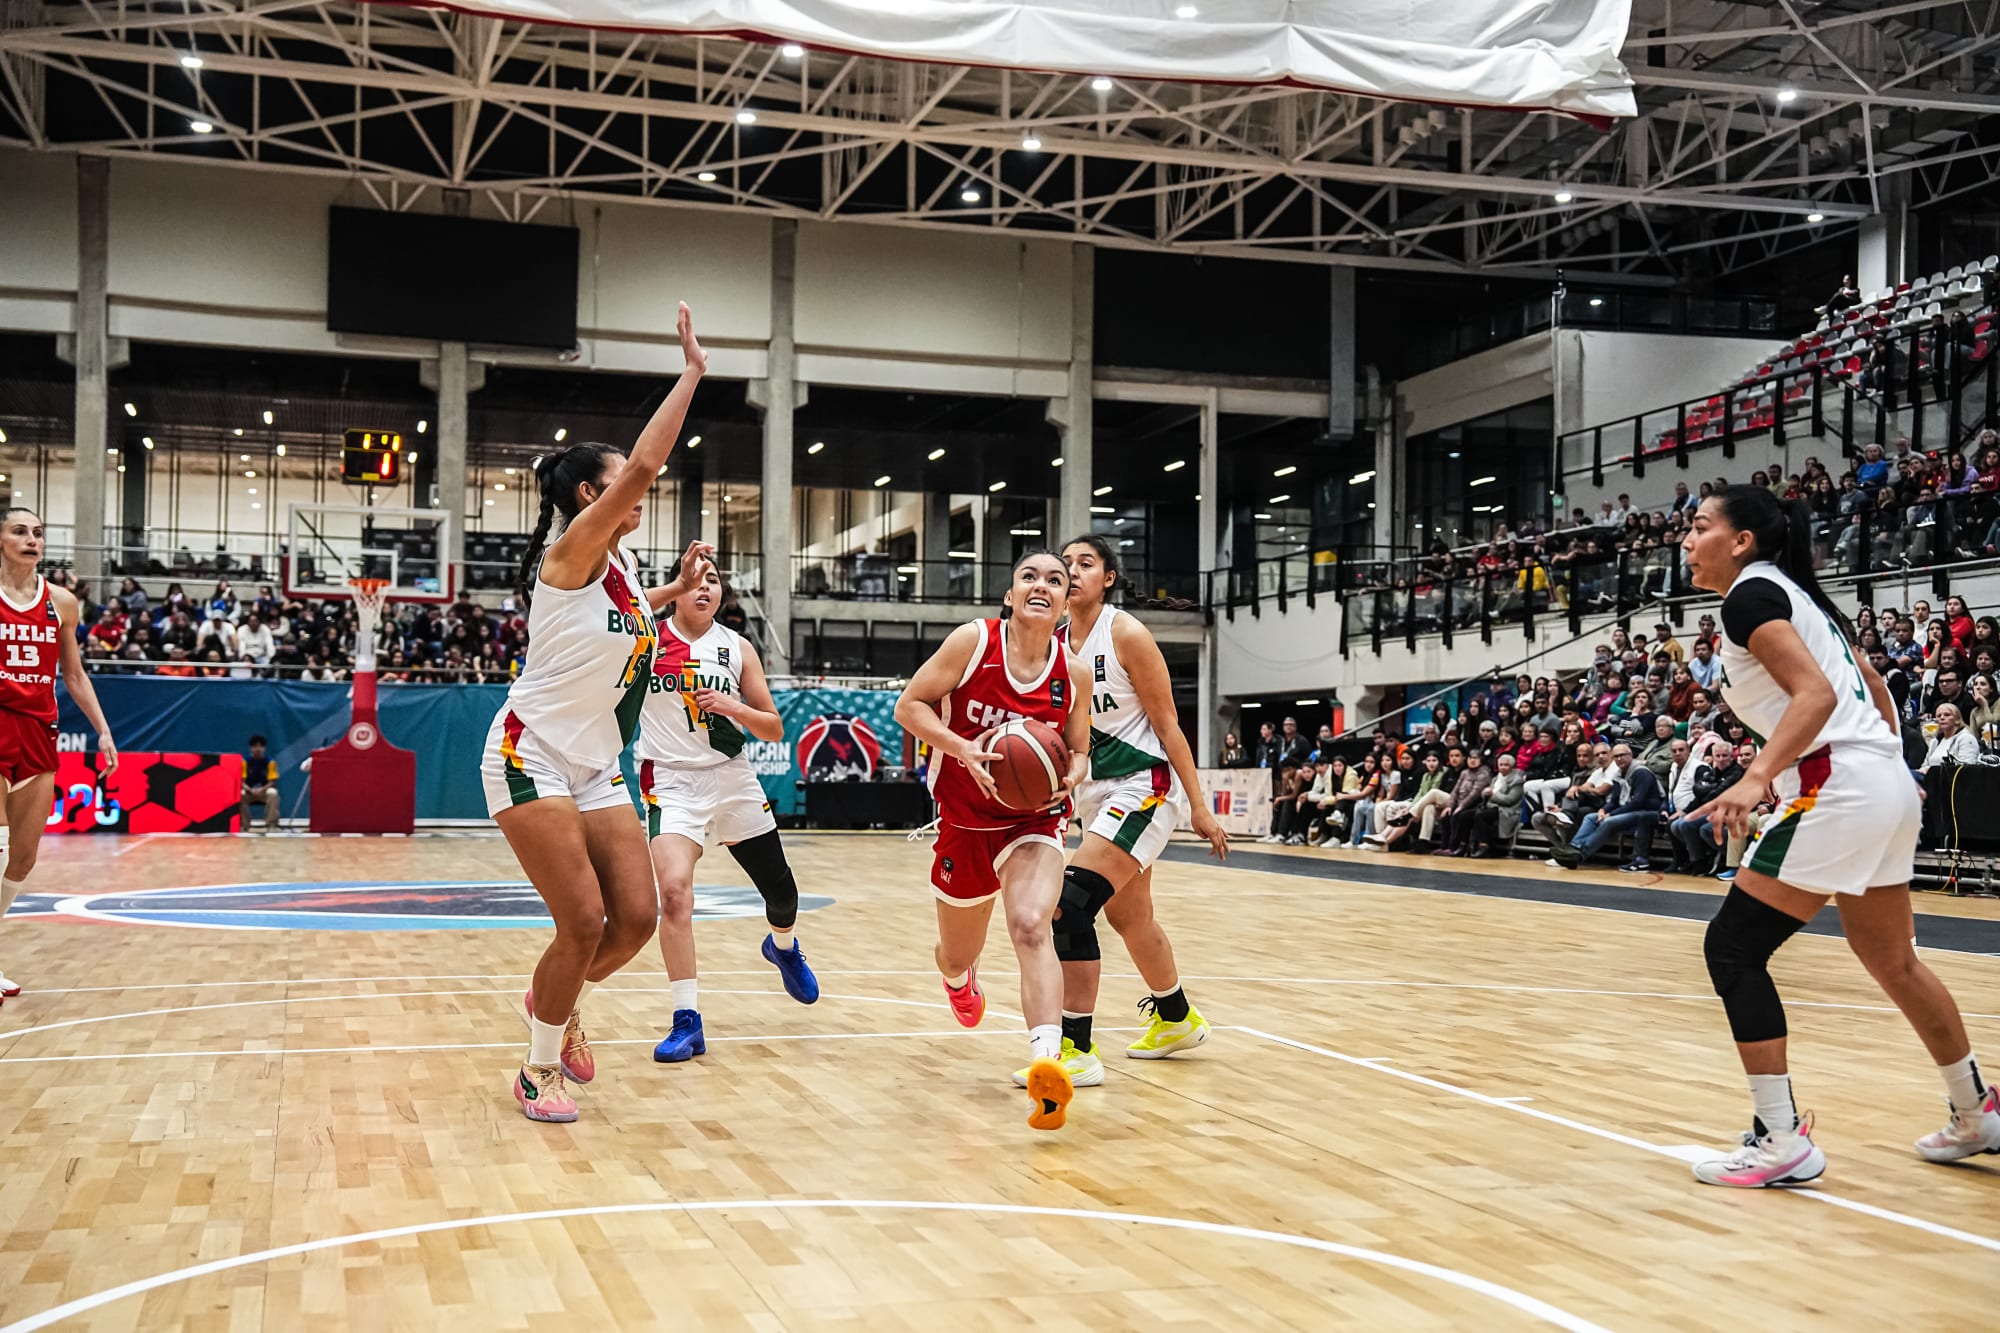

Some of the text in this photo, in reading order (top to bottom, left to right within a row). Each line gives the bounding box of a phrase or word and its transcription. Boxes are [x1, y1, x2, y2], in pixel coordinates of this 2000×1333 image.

[0, 623, 57, 643] HILE
[6, 644, 40, 667] 13
[0, 670, 40, 684] OOLBET
[614, 653, 649, 689] 15
[650, 672, 731, 696] BOLIVIA
[683, 705, 714, 733] 14
[56, 732, 87, 752] AN
